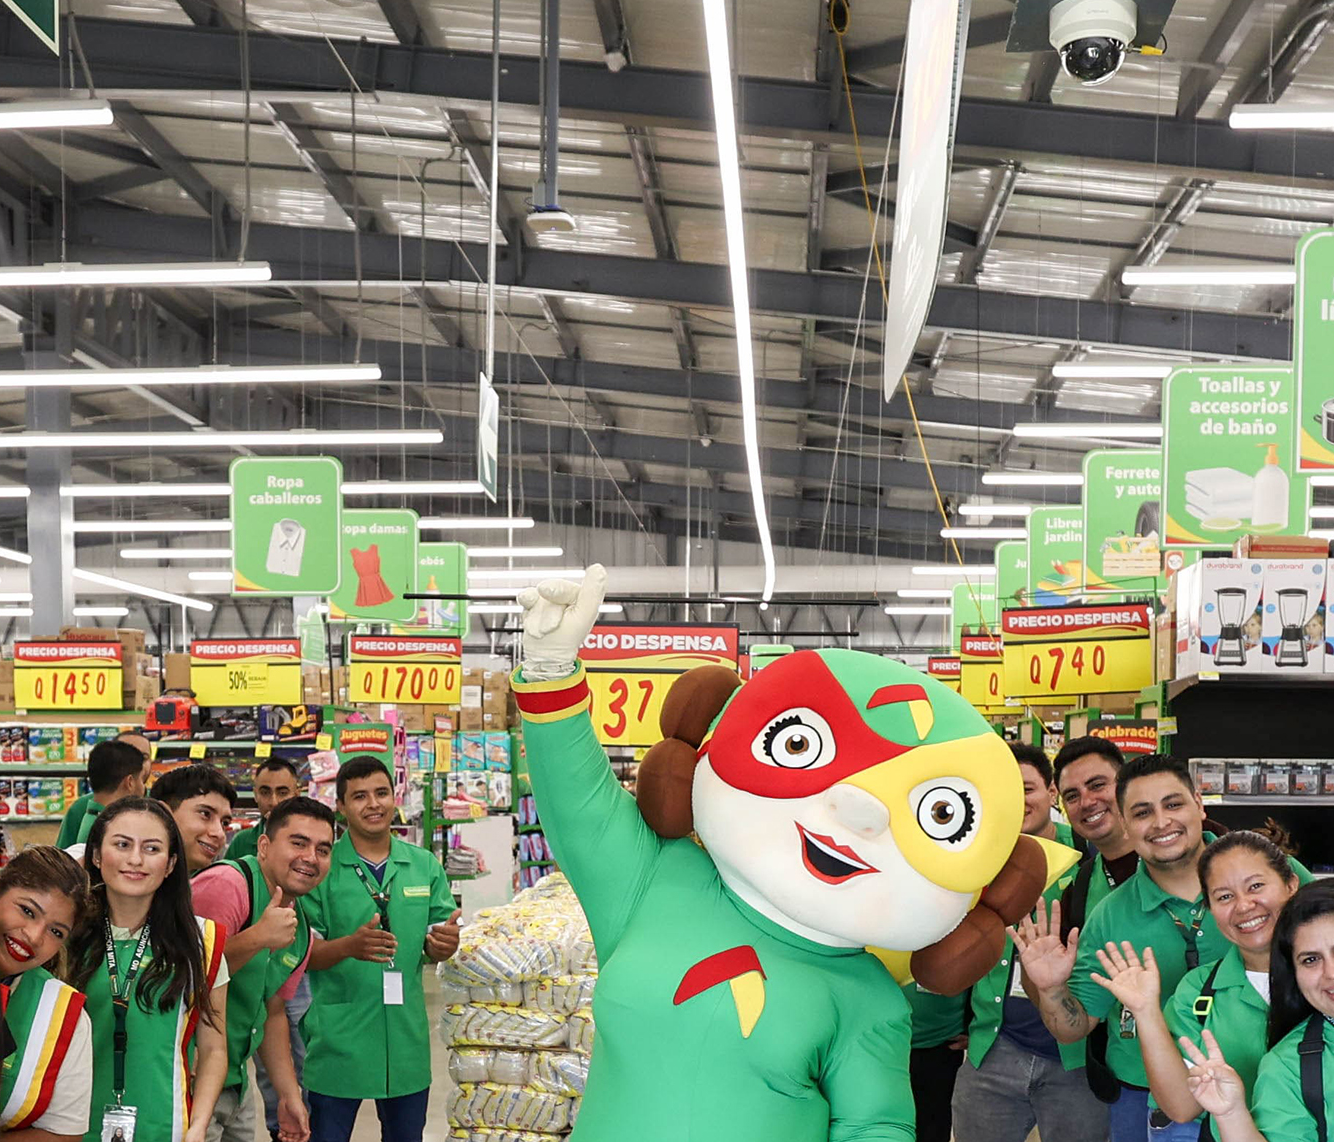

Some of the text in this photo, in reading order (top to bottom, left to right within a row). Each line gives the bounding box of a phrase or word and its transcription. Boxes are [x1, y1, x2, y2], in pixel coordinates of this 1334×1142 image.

[1199, 377, 1281, 397] Toallas y
[1189, 399, 1289, 415] accesorios
[1200, 417, 1277, 436] de baño
[1105, 466, 1160, 479] Ferrete
[267, 475, 304, 491] Ropa
[1115, 485, 1125, 498] y
[249, 492, 323, 505] caballeros
[369, 523, 409, 535] damas
[419, 556, 446, 566] ebés
[1008, 611, 1143, 628] PRECIO DESPENSA
[355, 640, 457, 653] PRECIO DESPENSA
[582, 634, 728, 651] CIO DESPENSA
[19, 646, 116, 658] PRECIO DESPENSA
[196, 644, 296, 655] PRECIO DESPENSA
[932, 662, 960, 671] PRECI
[229, 671, 248, 691] 50%
[338, 729, 388, 742] Juguetes
[1089, 725, 1158, 740] Celebració
